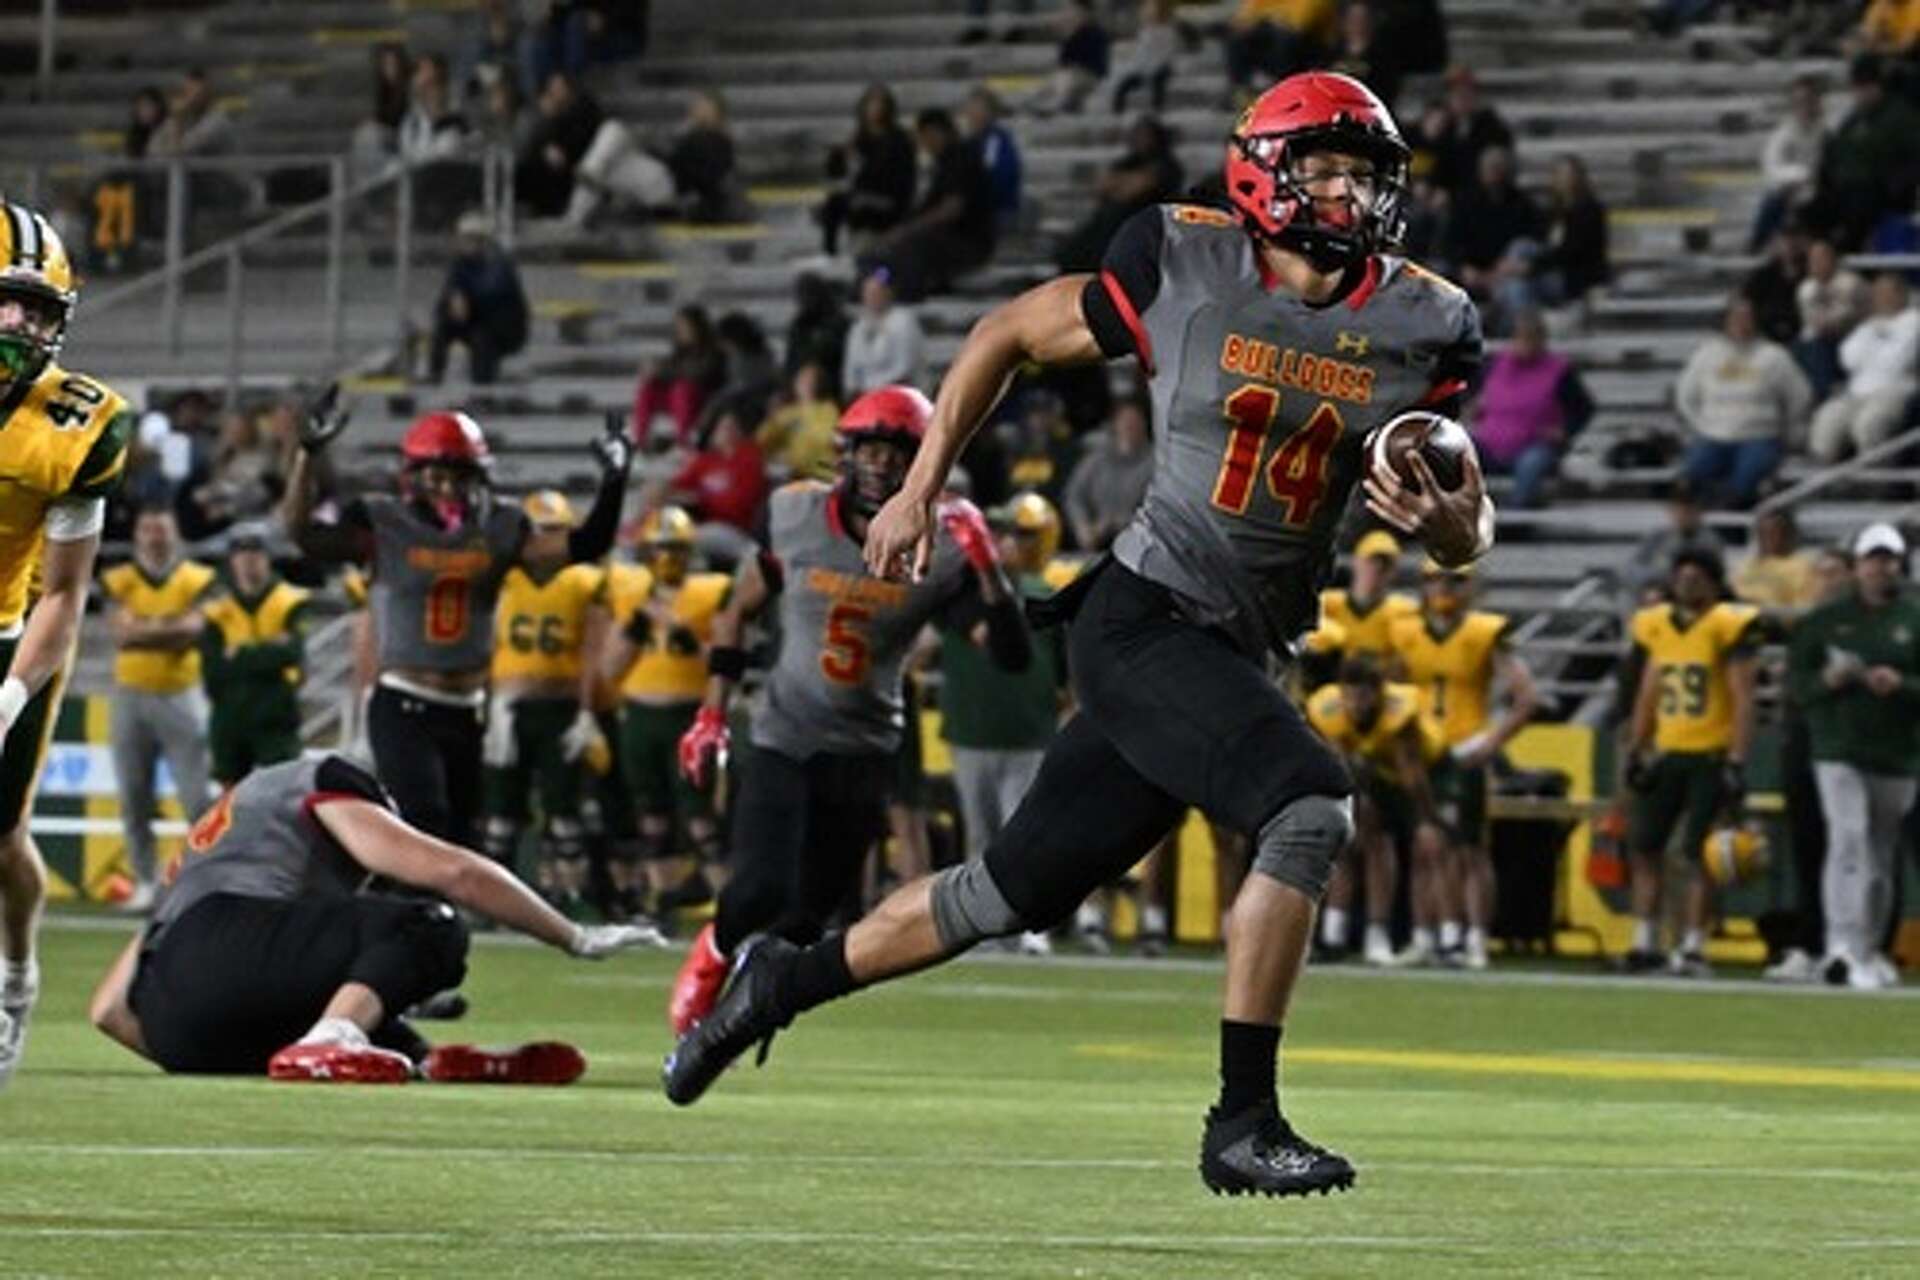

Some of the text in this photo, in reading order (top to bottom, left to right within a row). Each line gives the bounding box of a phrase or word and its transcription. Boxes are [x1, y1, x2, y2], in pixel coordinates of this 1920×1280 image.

[45, 378, 105, 428] 40
[1211, 383, 1345, 527] 14
[424, 572, 469, 645] 0
[819, 602, 873, 685] 5
